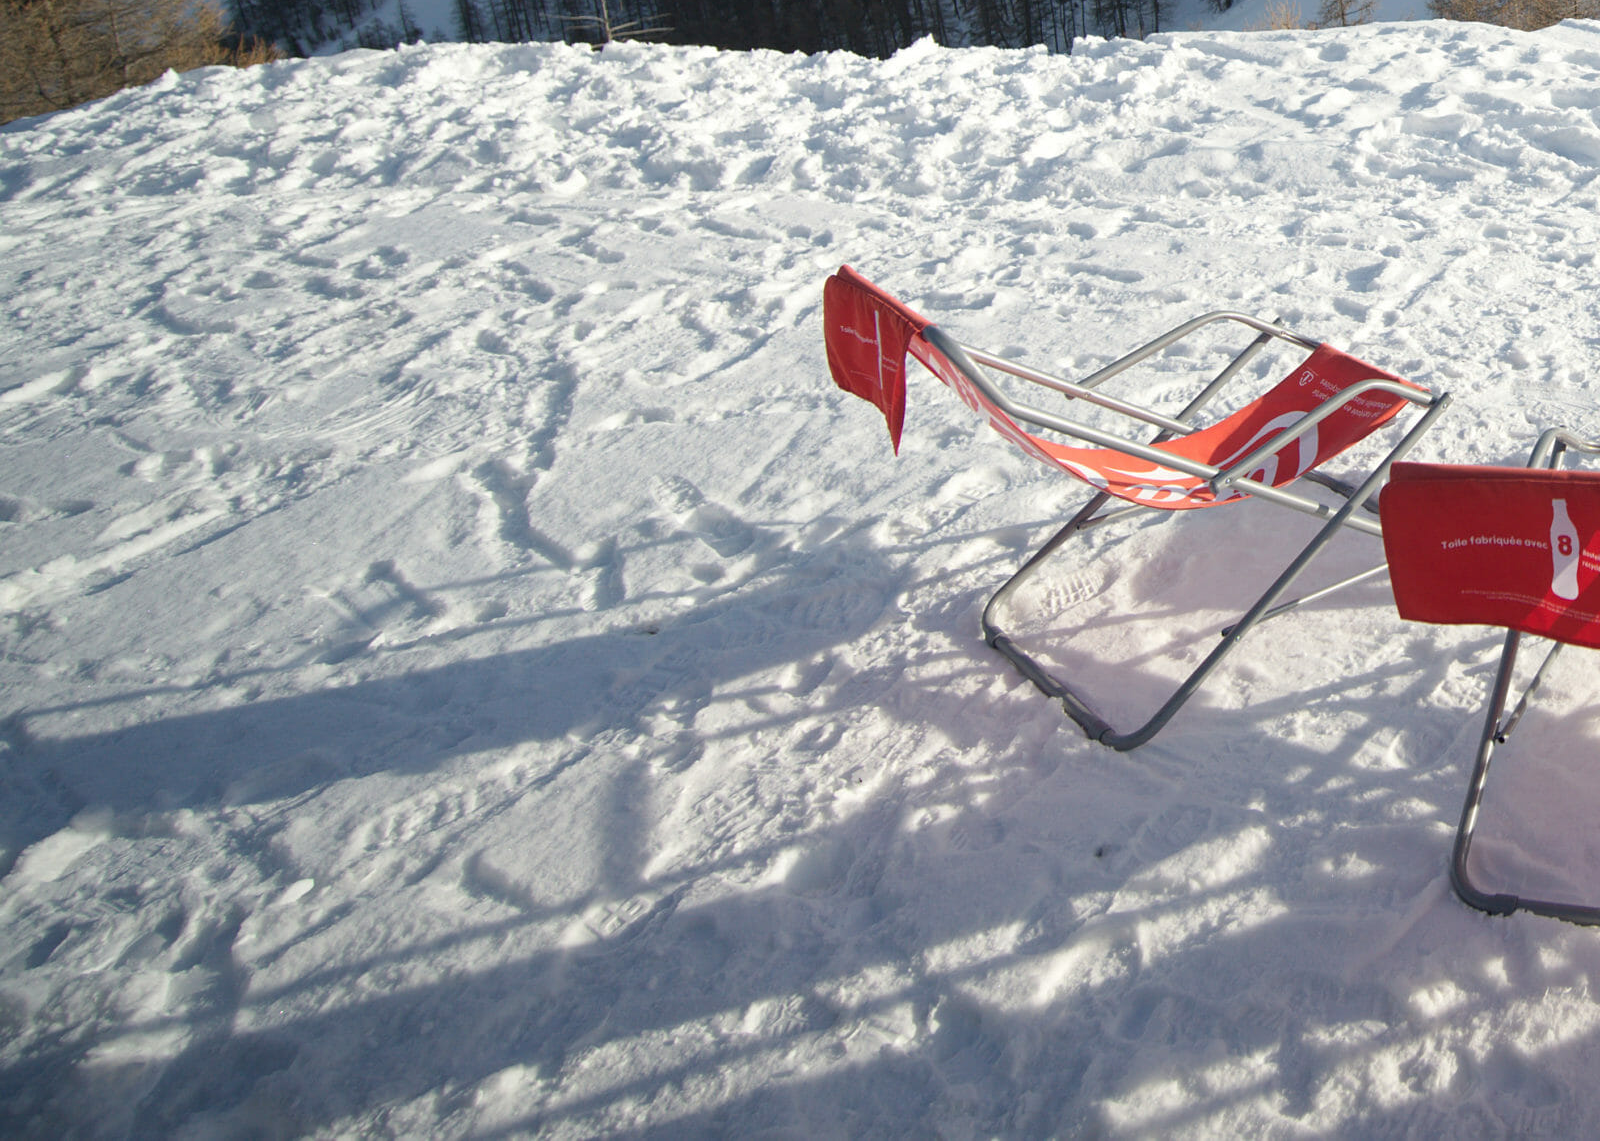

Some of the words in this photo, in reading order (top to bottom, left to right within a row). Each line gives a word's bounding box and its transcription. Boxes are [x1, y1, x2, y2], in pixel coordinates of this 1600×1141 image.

[1441, 538, 1468, 549] Toile
[1470, 535, 1522, 546] fabriquée
[1524, 539, 1548, 549] avec
[1557, 534, 1573, 556] 8
